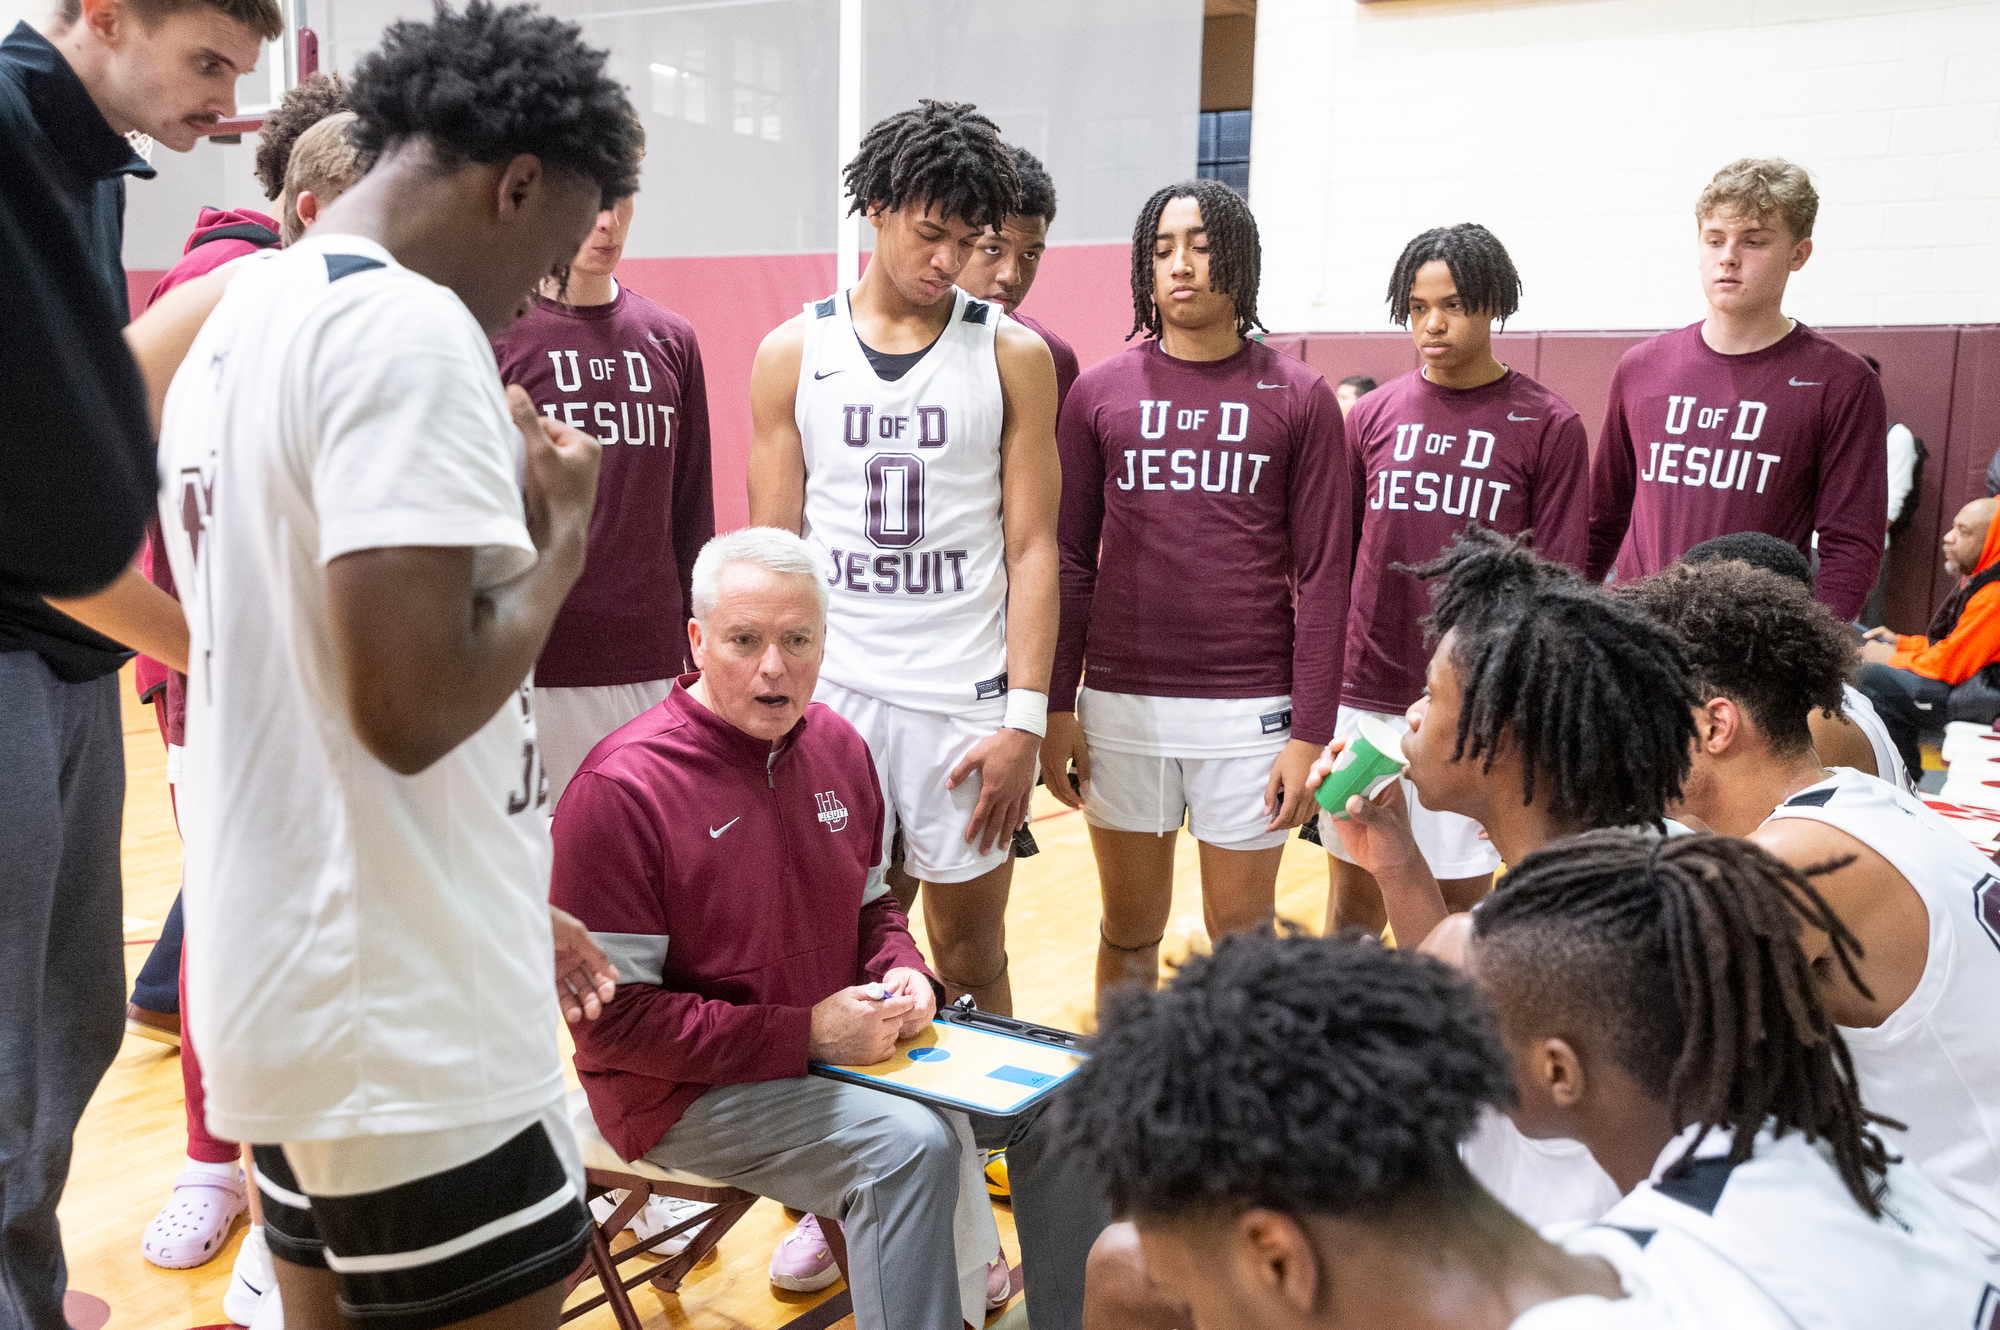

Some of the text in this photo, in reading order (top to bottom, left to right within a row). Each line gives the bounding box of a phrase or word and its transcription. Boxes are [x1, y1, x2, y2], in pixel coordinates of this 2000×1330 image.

[548, 350, 652, 393] U OF D
[843, 404, 948, 448] U OF D
[1140, 400, 1249, 442] U OF D
[1665, 395, 1768, 441] U OF D
[1393, 423, 1496, 470] U OF D
[1641, 442, 1781, 494] JESUIT
[1117, 449, 1271, 494] JESUIT
[1370, 470, 1511, 522] JESUIT
[825, 547, 967, 594] JESUIT
[820, 808, 846, 821] JESUIT
